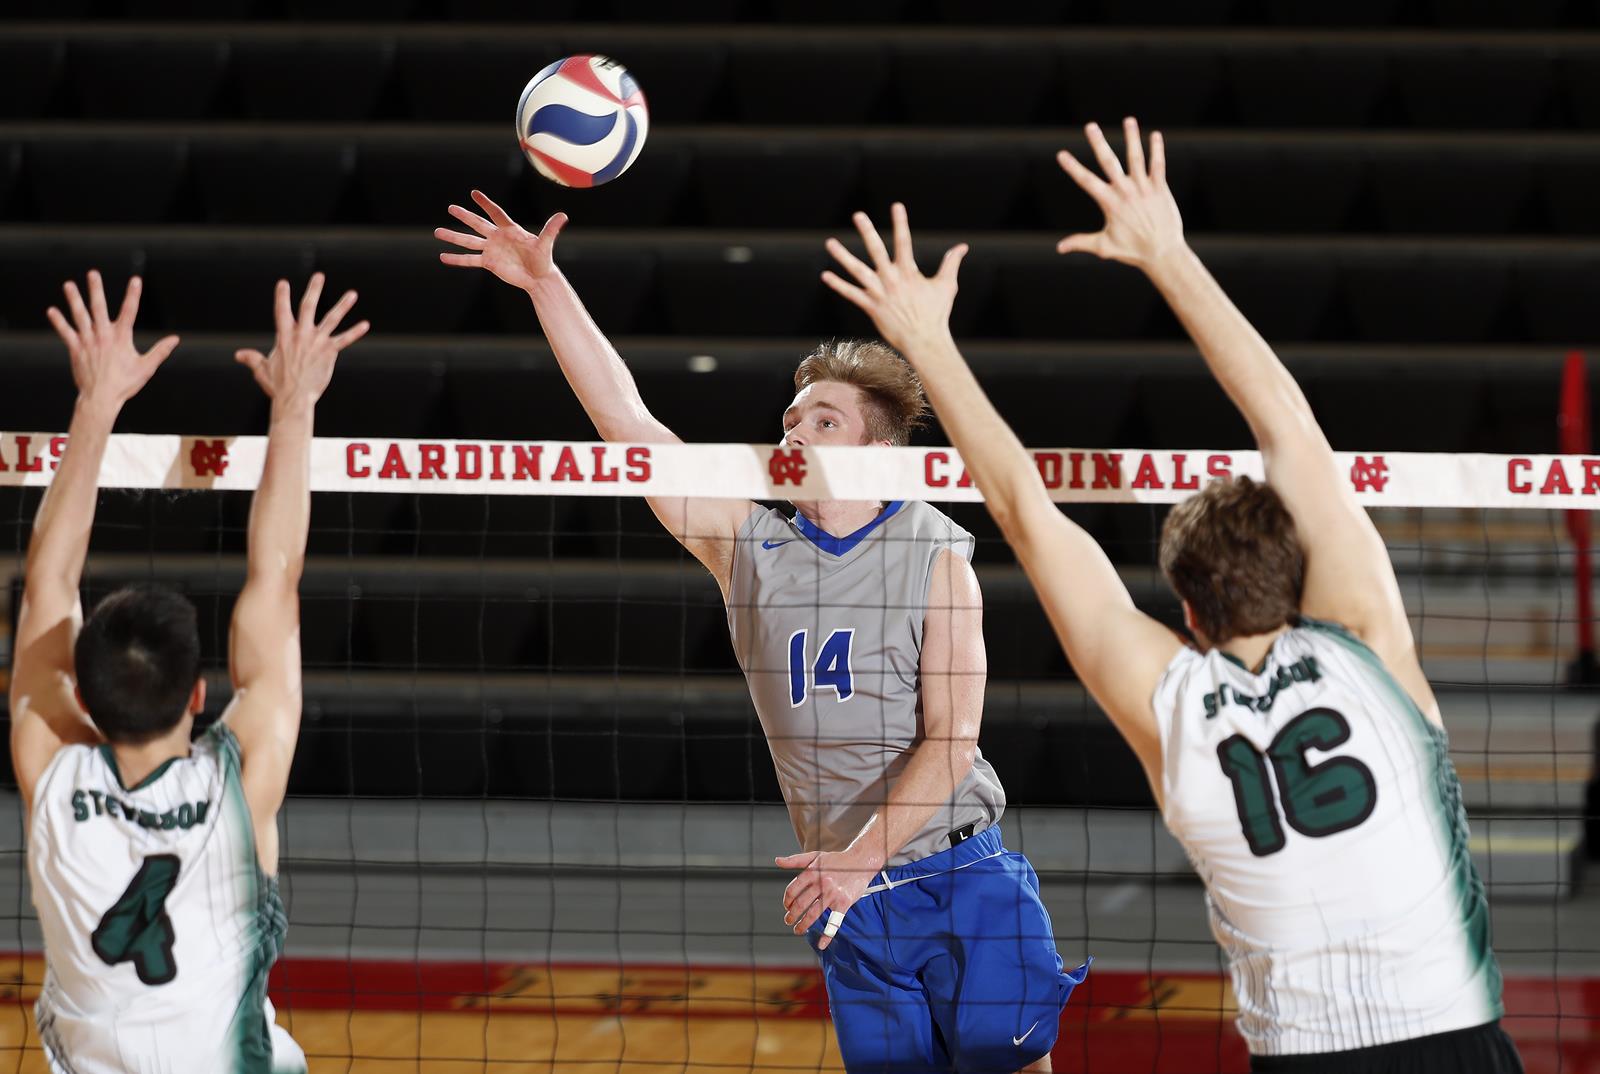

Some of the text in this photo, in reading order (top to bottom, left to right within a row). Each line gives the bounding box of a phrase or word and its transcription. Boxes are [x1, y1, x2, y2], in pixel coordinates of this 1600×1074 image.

[0, 436, 68, 472] LS
[346, 443, 652, 483] CARDINALS
[924, 452, 1233, 489] CDINALS
[788, 628, 855, 708] 14
[1203, 655, 1322, 719] STNSON
[72, 789, 210, 830] STEVSON
[1217, 707, 1377, 857] 16
[959, 831, 968, 841] L
[91, 853, 181, 986] 4
